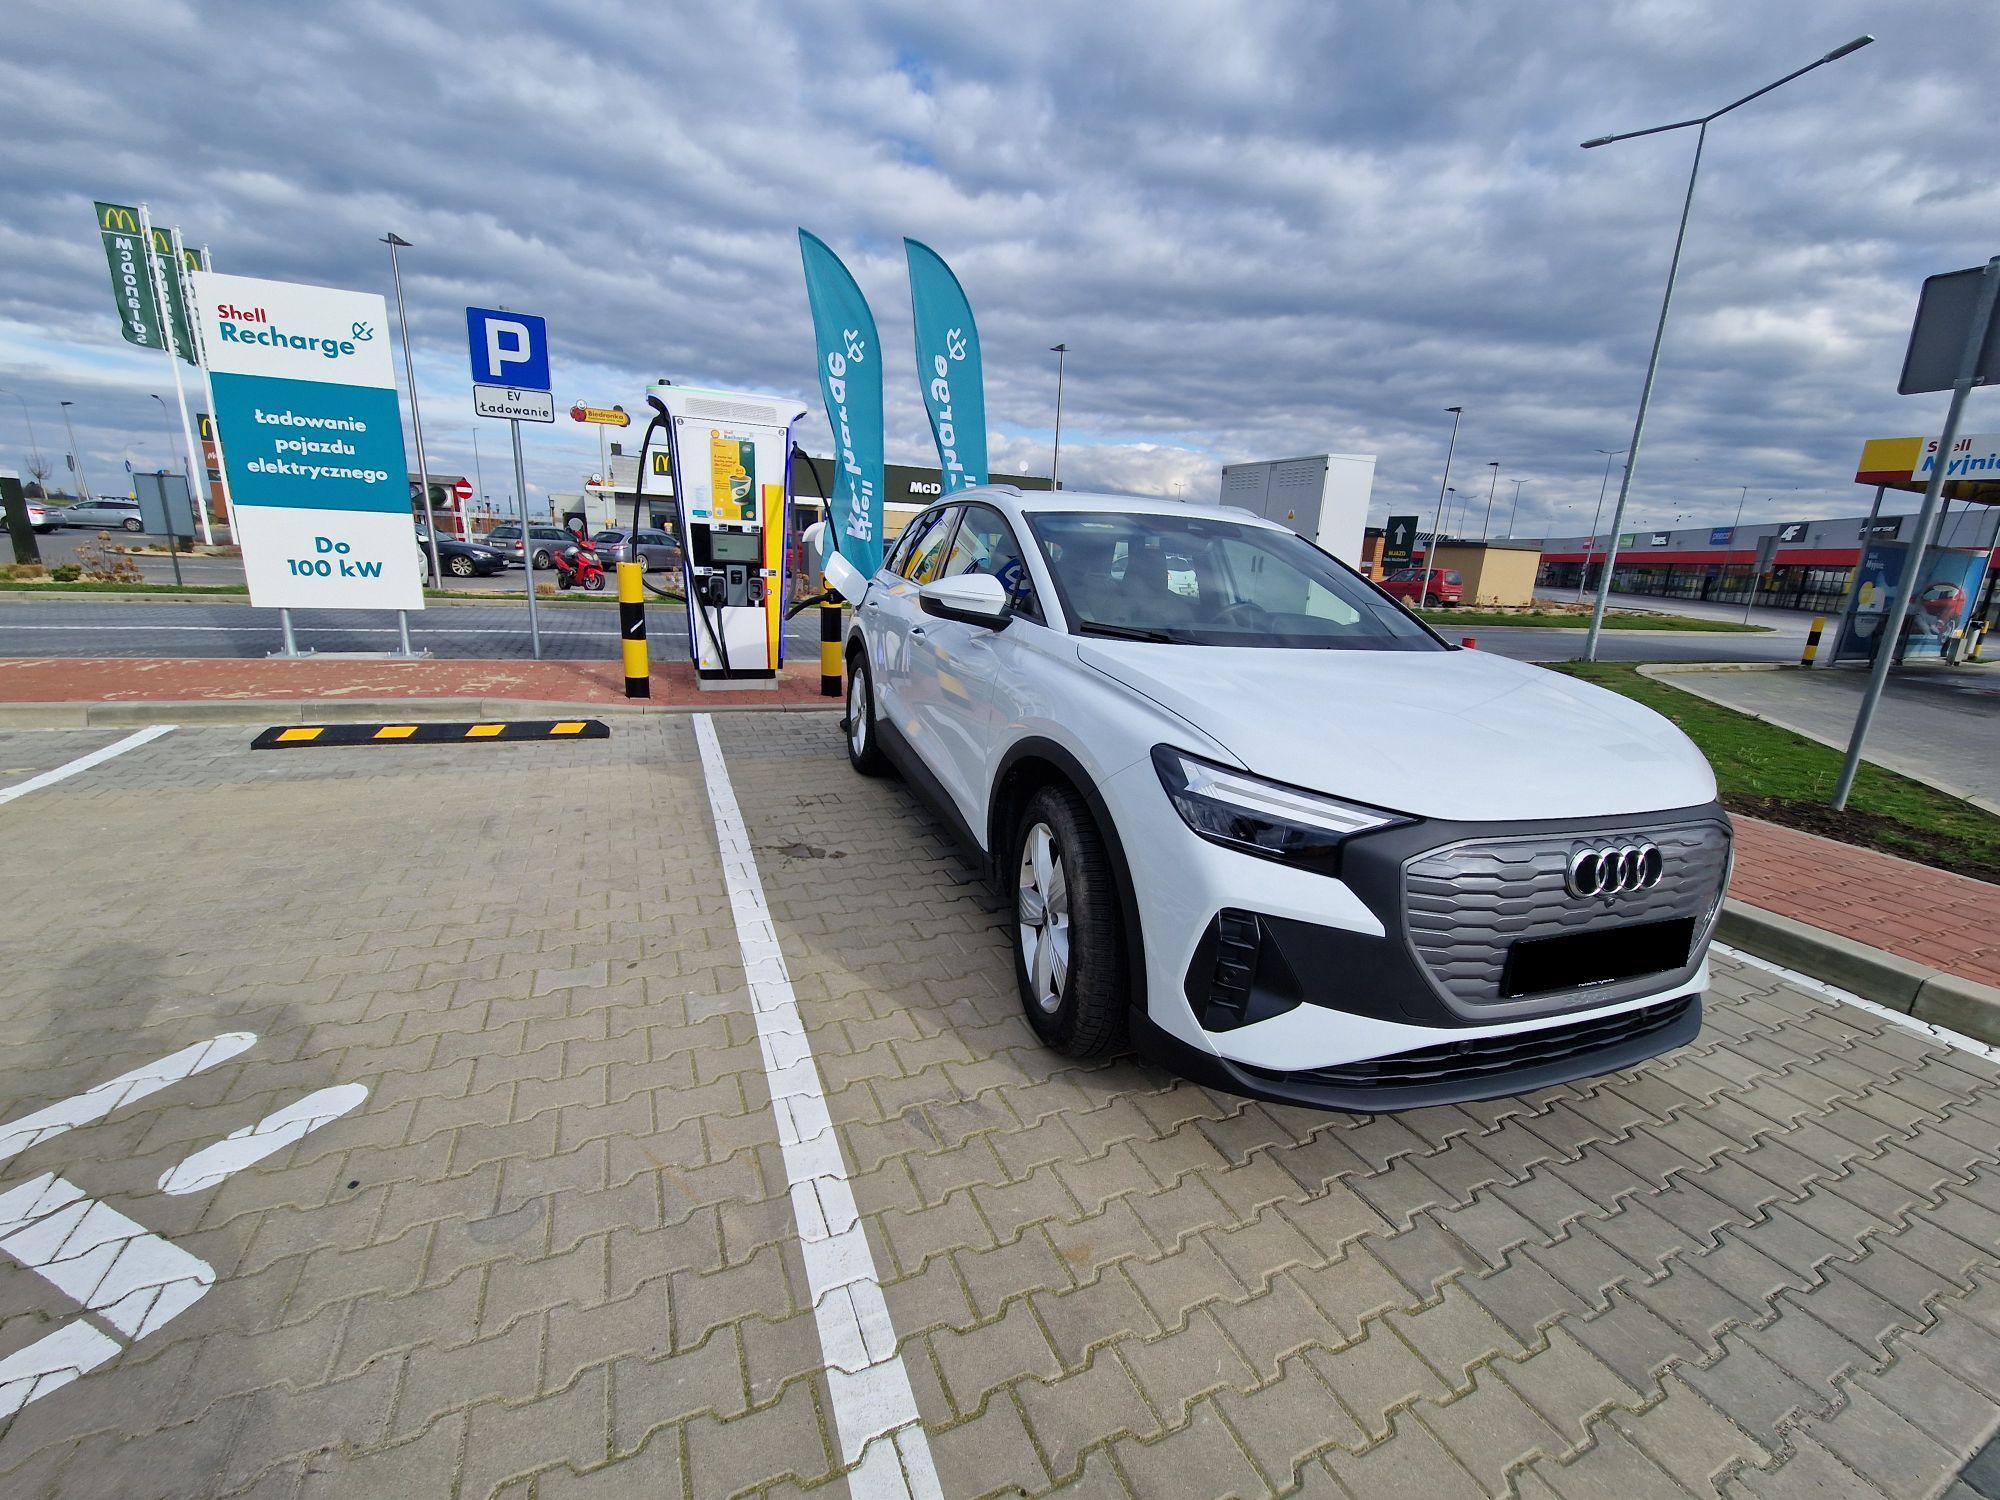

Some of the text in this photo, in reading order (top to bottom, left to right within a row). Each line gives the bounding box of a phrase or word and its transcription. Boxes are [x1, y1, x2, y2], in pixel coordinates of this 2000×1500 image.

[217, 304, 267, 323] Shell
[219, 322, 355, 358] Recharge
[484, 317, 531, 377] P
[507, 391, 521, 401] EV
[480, 402, 549, 418] Ładowanie
[587, 410, 624, 420] Biedronka
[254, 408, 367, 433] Ładowanie
[275, 436, 356, 456] pojazdu
[247, 457, 389, 484] elektrycznego
[1780, 525, 1801, 541] 4F
[1858, 525, 1896, 533] derse
[315, 536, 351, 554] Do
[287, 559, 383, 577] 100 kW
